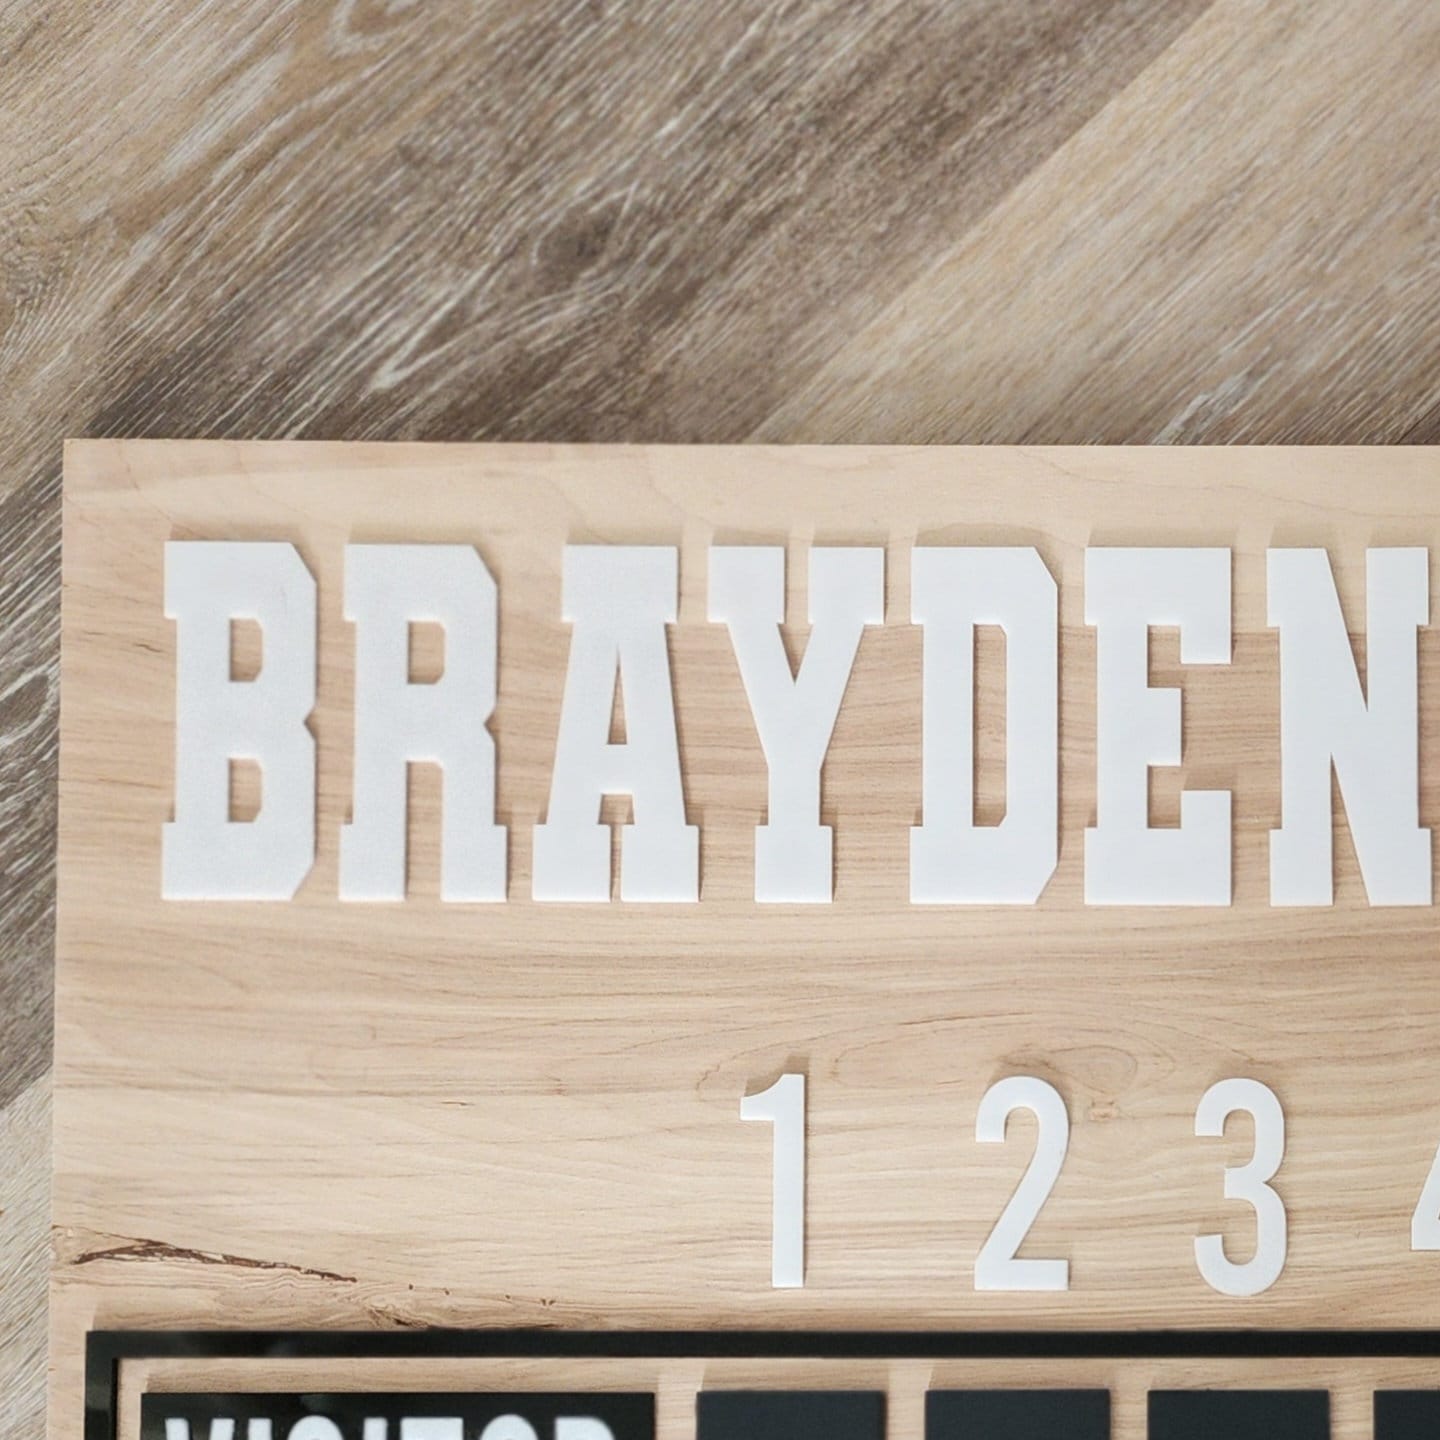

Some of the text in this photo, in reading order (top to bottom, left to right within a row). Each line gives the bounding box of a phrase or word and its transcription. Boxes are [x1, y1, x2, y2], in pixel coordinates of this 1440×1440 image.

[160, 538, 1433, 908] BRAYDEN
[738, 1075, 806, 1291] 1
[974, 1075, 1070, 1293] 2
[1193, 1078, 1287, 1296] 3
